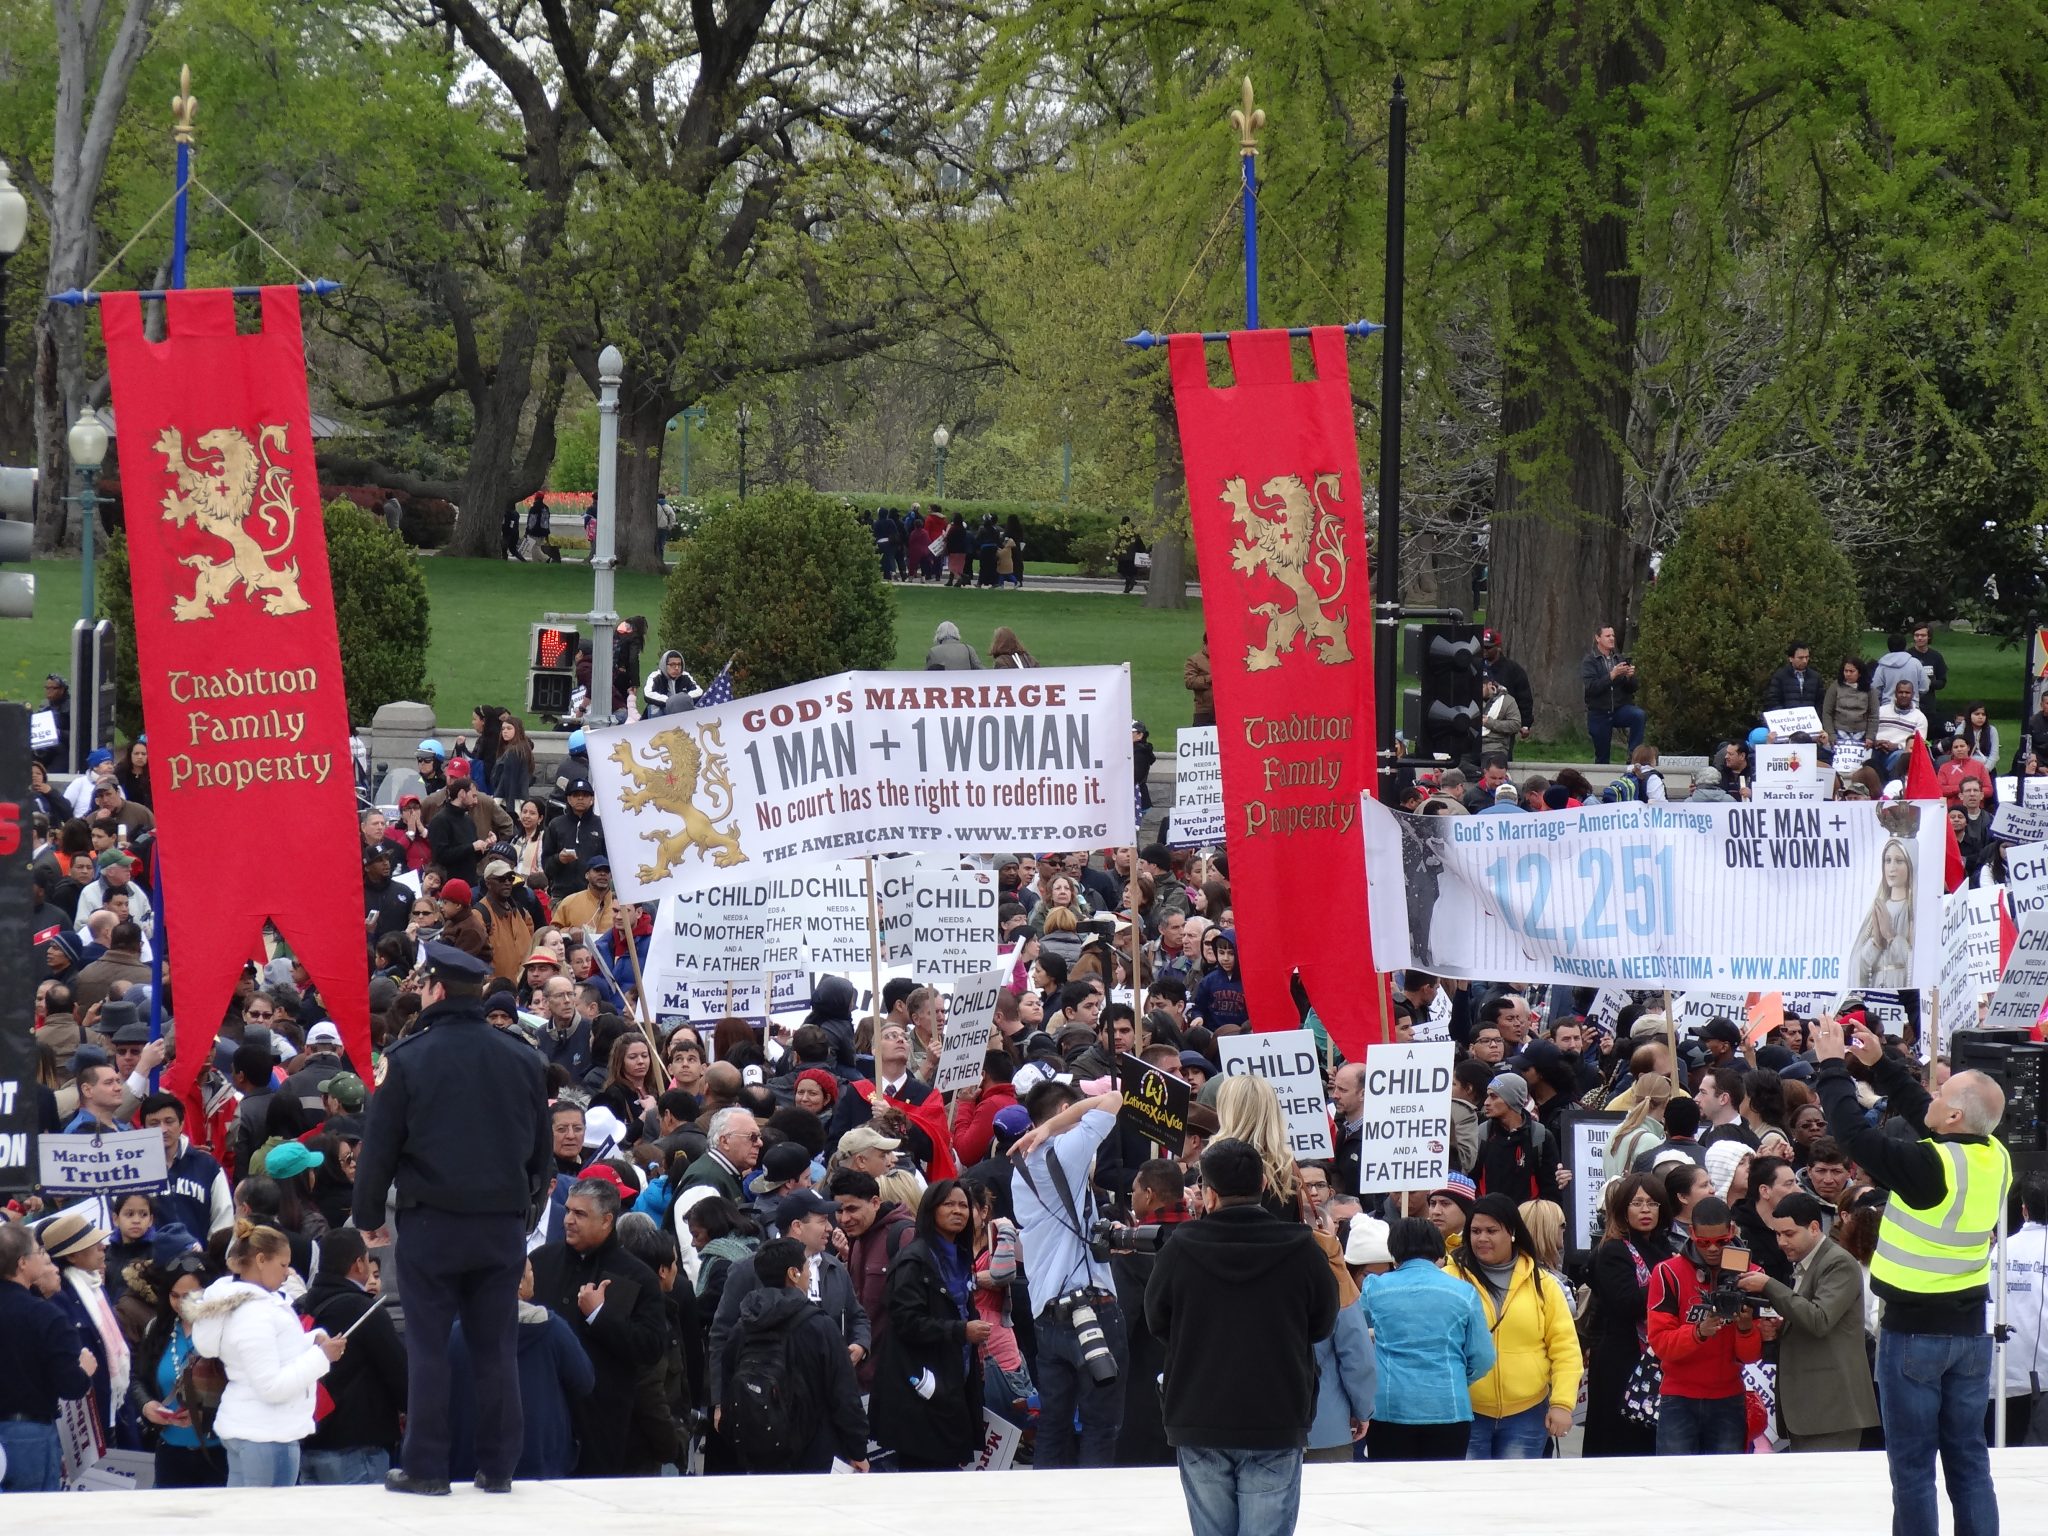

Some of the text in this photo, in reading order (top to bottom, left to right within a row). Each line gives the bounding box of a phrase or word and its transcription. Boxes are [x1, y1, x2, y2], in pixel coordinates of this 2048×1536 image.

[168, 667, 317, 704] Tradition
[742, 690, 853, 732] GOD'S
[864, 684, 1066, 710] MARRIAGE
[188, 709, 305, 746] Family
[1243, 713, 1352, 749] Tradition
[1780, 722, 1812, 732] Verdad
[744, 740, 767, 795] 1
[772, 720, 857, 790] MAN
[912, 717, 927, 772] 1
[940, 714, 1103, 772] WOMAN.
[1179, 741, 1220, 758] CHIL
[168, 752, 331, 791] Property
[1263, 757, 1342, 792] Family
[1766, 762, 1789, 771] PURO
[1178, 769, 1222, 783] MOTHE
[755, 776, 1106, 831] No court has the right to redefine it.
[1179, 793, 1223, 806] FATHE
[1763, 791, 1814, 800] March for
[1174, 815, 1207, 826] Marcha
[1454, 807, 1713, 842] God's Marriage
[1728, 808, 1767, 839] ONE
[1774, 808, 1821, 838] MAN
[2006, 813, 2036, 827] March
[1184, 824, 1226, 837] Verdad
[2007, 823, 2044, 838] Truth
[763, 823, 1107, 863] THE AMERICAN TFP WWW.TFP.ORG
[1725, 837, 1850, 868] ONE WOMAN
[915, 860, 922, 868] A
[952, 874, 959, 882] A
[707, 886, 768, 907] CHILD
[768, 878, 804, 900] ILD
[916, 888, 995, 909] CHILD
[1485, 844, 1675, 954] 12,251
[826, 905, 849, 913] NEEDS
[1968, 903, 2000, 925] ILD
[766, 916, 802, 932] THER
[807, 917, 870, 931] MOTHE
[938, 916, 964, 924] NEEDS
[1941, 900, 1967, 946] CHILD
[703, 926, 764, 940] MOTHER
[914, 927, 995, 942] MOTHER
[763, 947, 798, 963] THER
[1968, 940, 2000, 957] THE
[703, 956, 760, 972] FATHER
[916, 959, 992, 974] FATHER
[1553, 955, 1840, 980] AMERICA NEEDS FATIMA WWW.ANF.ORG
[1941, 940, 1968, 981] MOTHER
[977, 977, 982, 985] A
[1968, 969, 2000, 985] THE
[692, 986, 727, 998] Marcha
[731, 987, 748, 997] por
[751, 985, 760, 994] la
[1710, 992, 1735, 1001] NEEDS
[1942, 974, 1967, 1016] FATHER
[953, 988, 997, 1016] CHILD
[1782, 1001, 1811, 1013] rdad
[1990, 1001, 2040, 1018] FATHER
[1600, 1007, 1618, 1028] Tru
[1684, 1001, 1749, 1022] MOTHE
[944, 1029, 989, 1051] MOTHER
[1262, 1039, 1270, 1047] A
[1407, 1050, 1414, 1059] A
[938, 1062, 980, 1084] FATHER
[1226, 1052, 1315, 1078] CHILD
[1369, 1067, 1449, 1096] CHILD
[1281, 1097, 1323, 1115] HER
[1390, 1104, 1425, 1114] NEEDS A
[1365, 1118, 1447, 1140] MOTHER
[52, 1147, 145, 1164] March for
[1393, 1146, 1409, 1155] AND
[1410, 1146, 1418, 1154] A
[60, 1163, 140, 1184] Truth
[1365, 1160, 1442, 1181] FATHER
[75, 1399, 90, 1451] Libe
